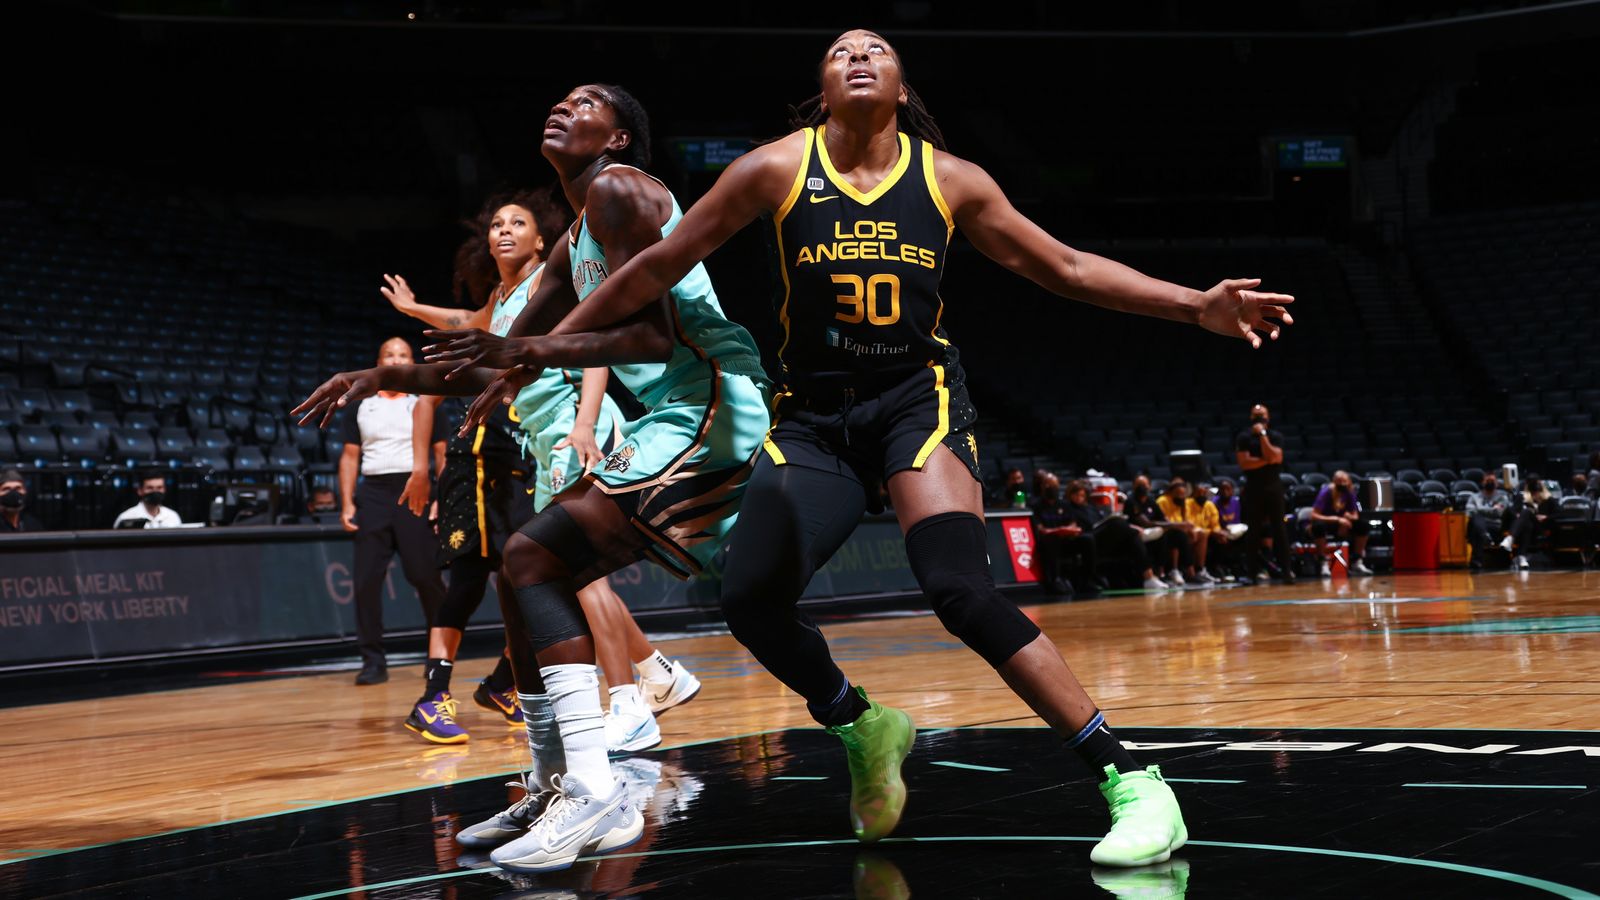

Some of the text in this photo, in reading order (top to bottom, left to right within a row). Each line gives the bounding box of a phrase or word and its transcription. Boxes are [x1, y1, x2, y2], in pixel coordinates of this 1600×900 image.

[834, 220, 898, 240] LOS
[795, 241, 936, 270] ANGELES
[830, 273, 901, 326] 30
[843, 336, 911, 356] EquiTrust
[0, 571, 165, 599] FICIAL MEAL KIT
[48, 600, 108, 624] YORK
[111, 596, 189, 620] LIBERTY
